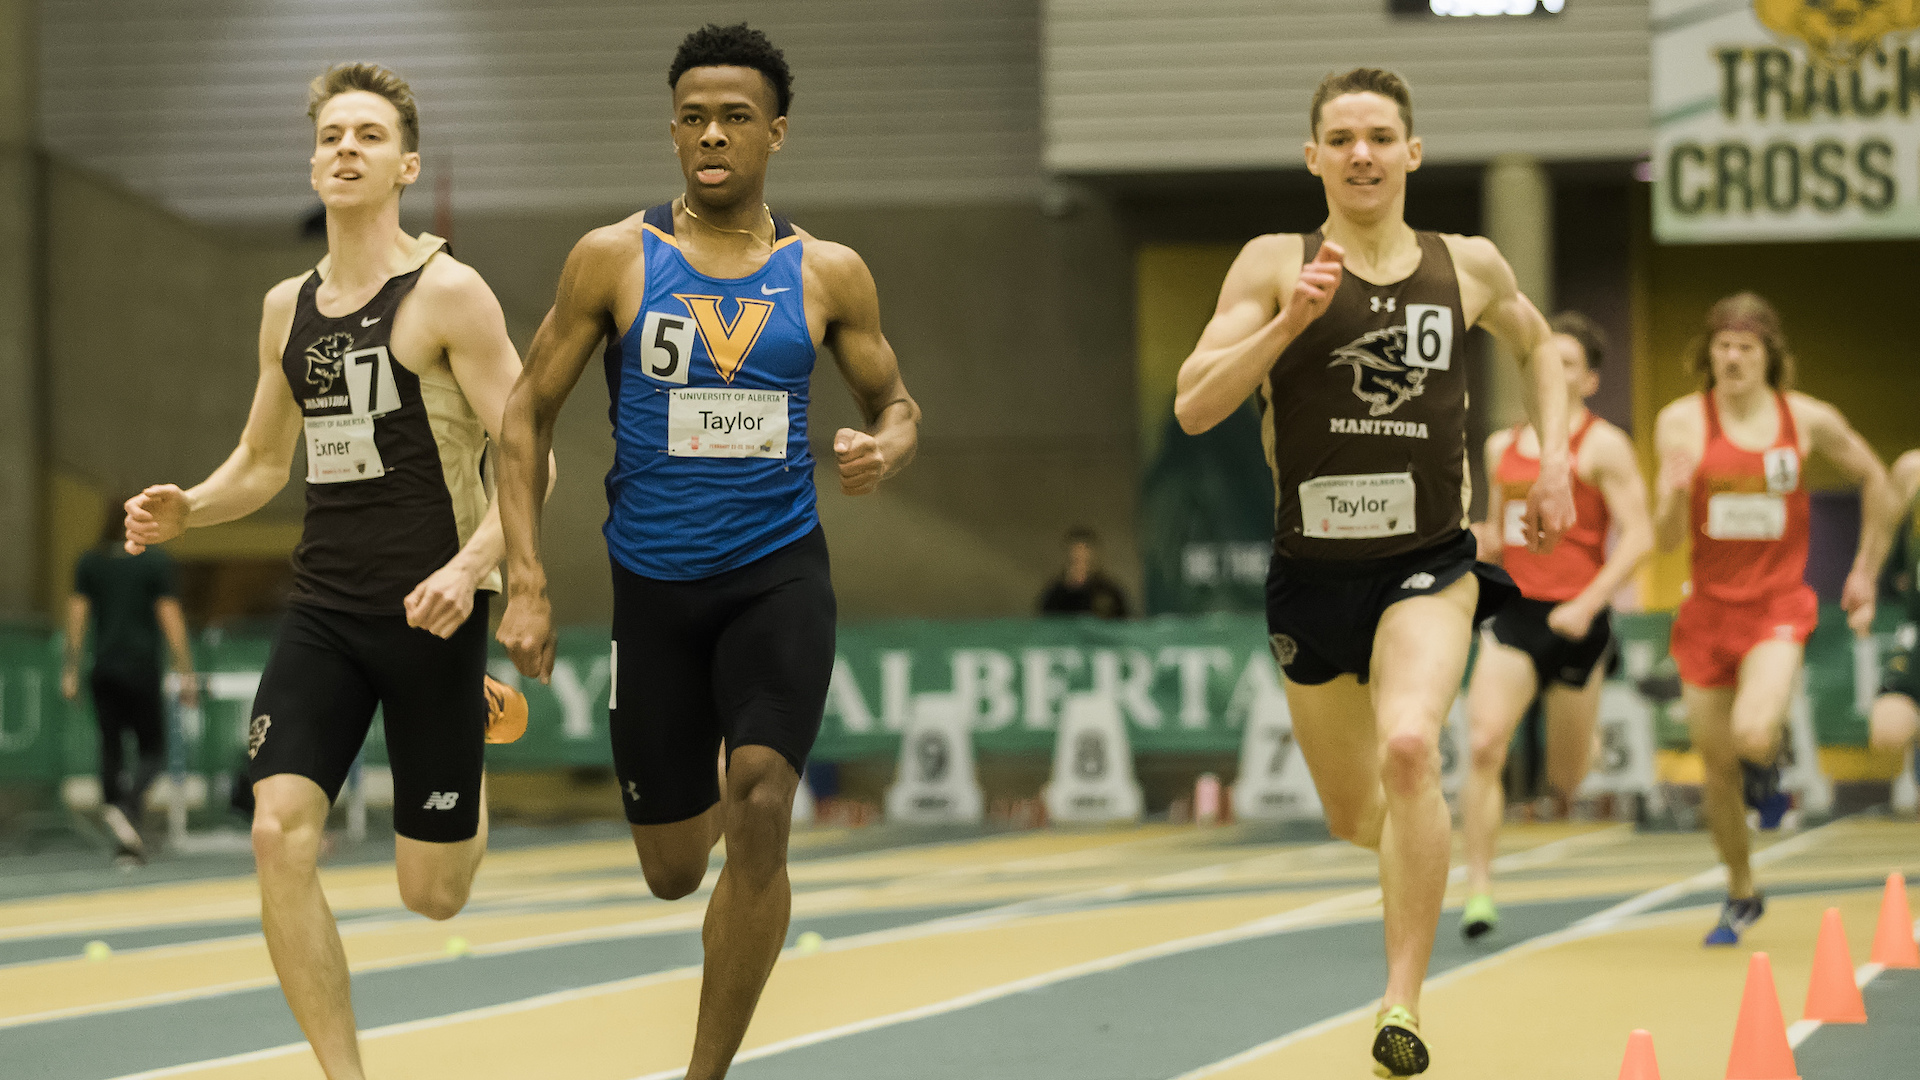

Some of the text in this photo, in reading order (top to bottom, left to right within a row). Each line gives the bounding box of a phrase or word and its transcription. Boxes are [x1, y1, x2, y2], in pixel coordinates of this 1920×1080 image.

[1669, 139, 1896, 214] CROSS
[651, 317, 684, 377] 5
[1418, 310, 1440, 361] 6
[355, 353, 379, 412] 7
[679, 392, 781, 402] UNIVERSITY OF ALBERTA
[699, 411, 764, 434] Taylor
[1330, 417, 1429, 439] MANITOBA
[315, 438, 351, 457] Exner
[1326, 496, 1388, 517] Taylor
